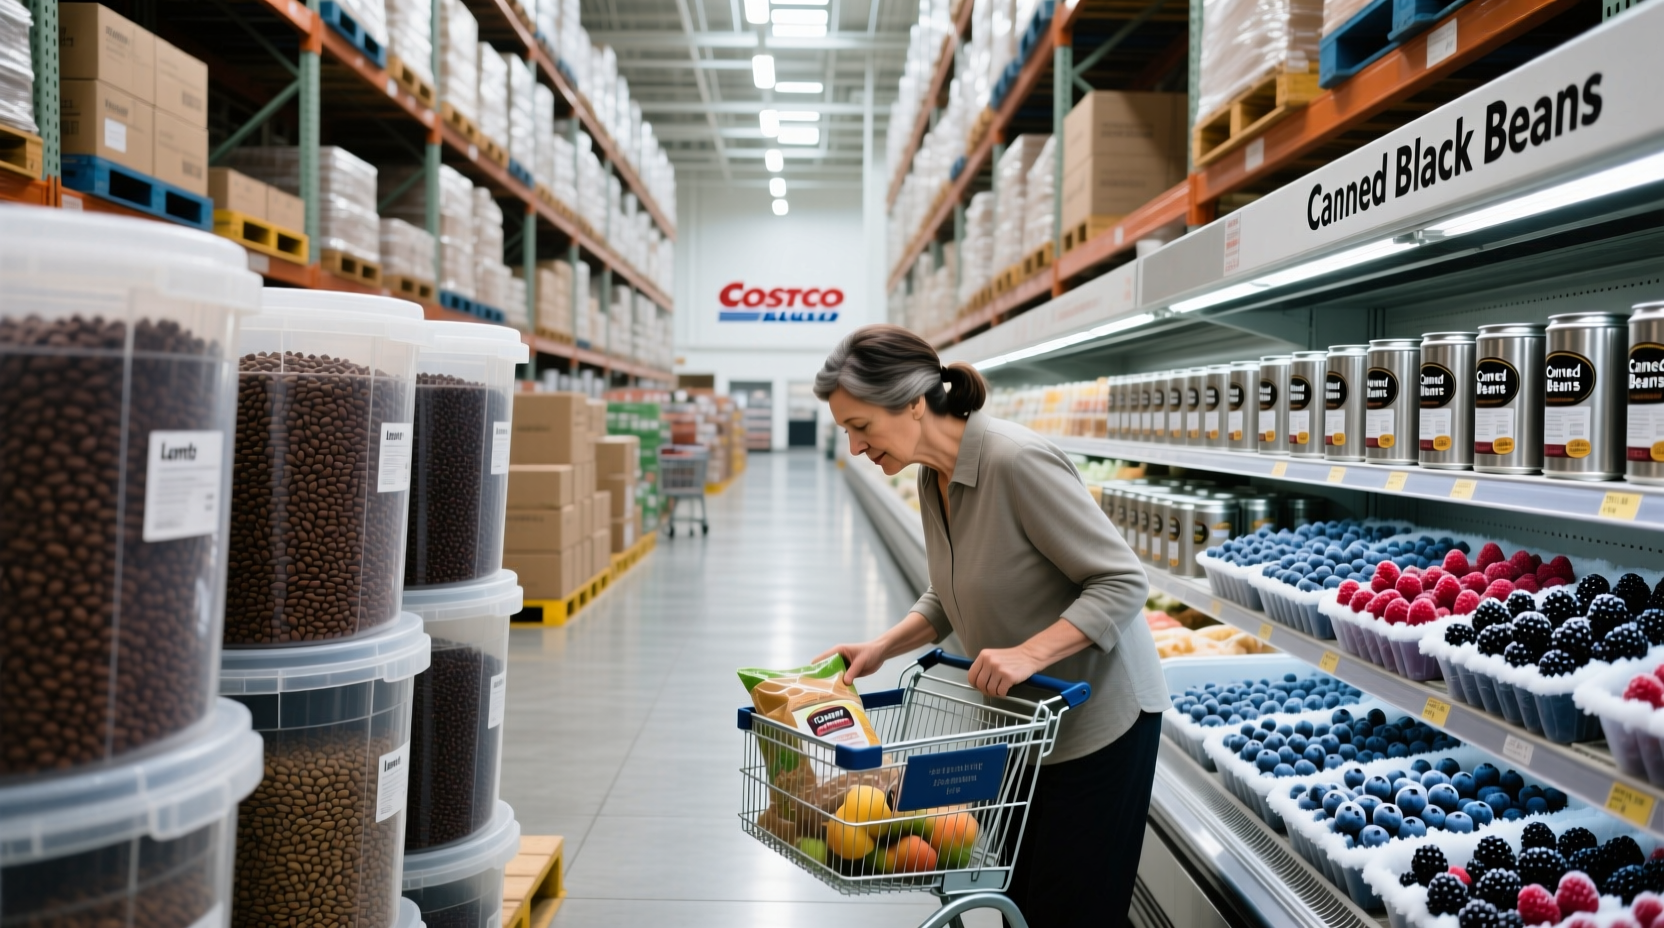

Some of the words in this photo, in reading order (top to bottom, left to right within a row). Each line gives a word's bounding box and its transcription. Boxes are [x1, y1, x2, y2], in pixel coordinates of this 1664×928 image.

[1307, 152, 1388, 230] Canned
[1395, 116, 1474, 198] Black
[1484, 72, 1603, 164] Beans
[719, 282, 844, 308] COSTCO
